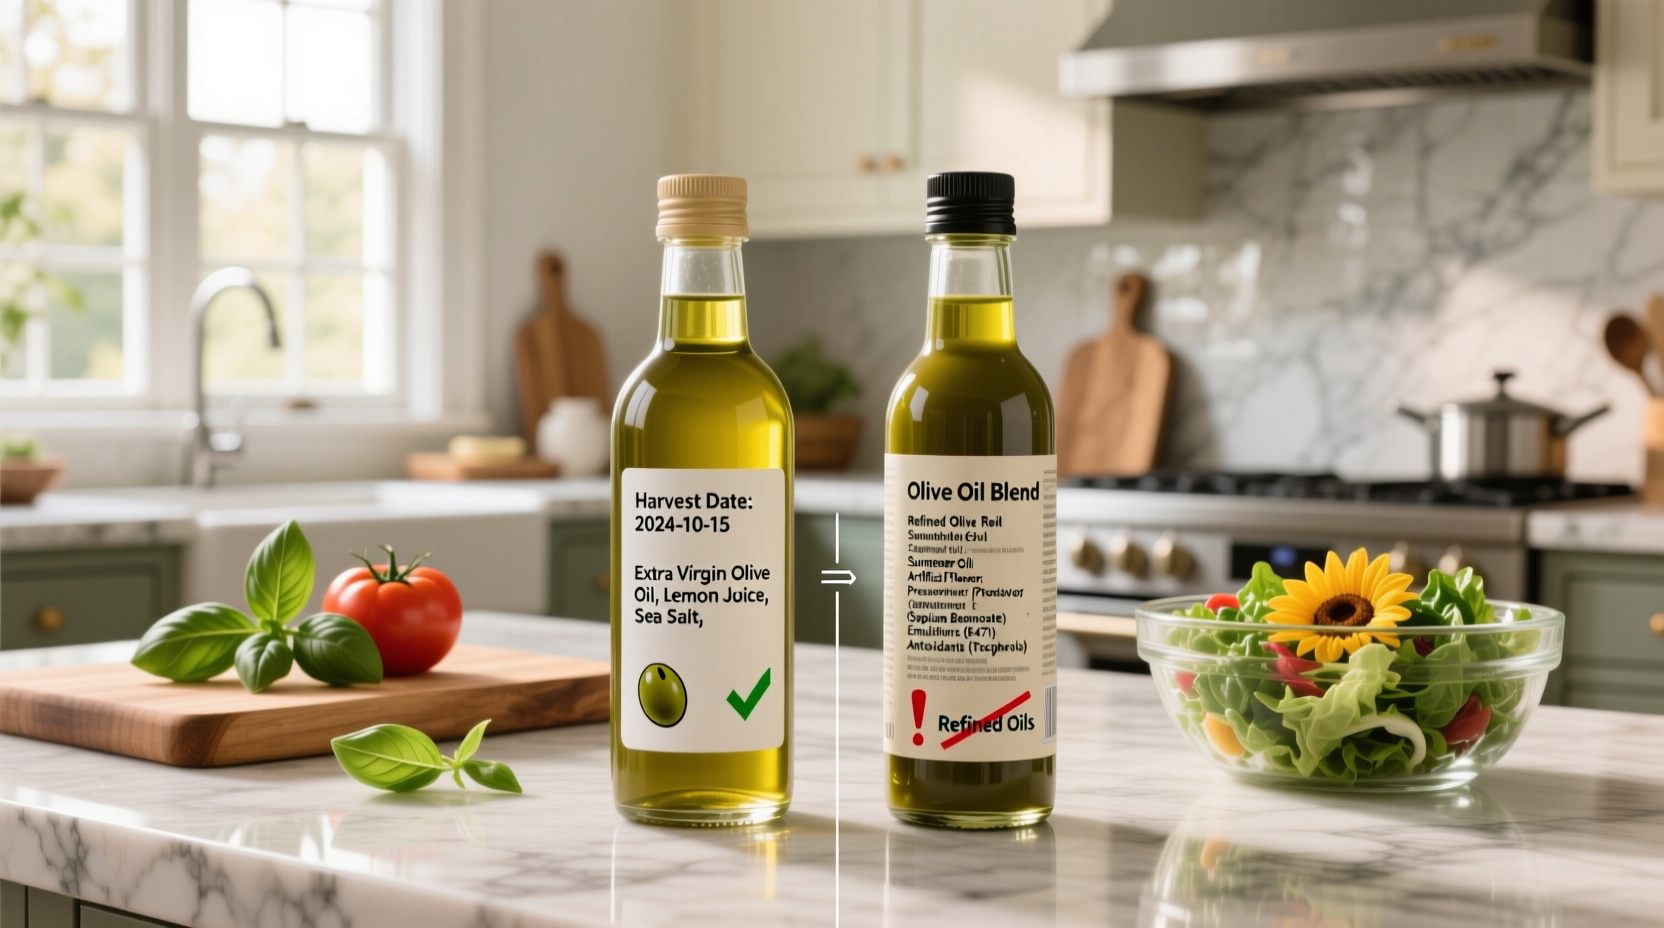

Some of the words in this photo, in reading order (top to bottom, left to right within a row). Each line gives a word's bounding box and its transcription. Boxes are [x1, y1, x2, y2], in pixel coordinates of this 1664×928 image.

[635, 491, 702, 510] Harvest
[706, 492, 753, 510] Date:
[907, 480, 953, 501] Olive
[957, 481, 985, 501] Oil
[990, 480, 1040, 501] Blend
[635, 515, 730, 533] 2024-10-15
[907, 514, 947, 528] Refined
[949, 515, 977, 528] Olive
[634, 565, 674, 581] Extra
[676, 564, 727, 586] Virgin
[731, 564, 771, 581] Olive
[634, 586, 659, 607] Oil,
[663, 587, 719, 604] Lemon
[722, 586, 769, 606] Juice,
[634, 607, 662, 625] Sea
[667, 608, 704, 629] Salt,
[938, 714, 1003, 733] Refined
[1007, 712, 1036, 732] Oils
